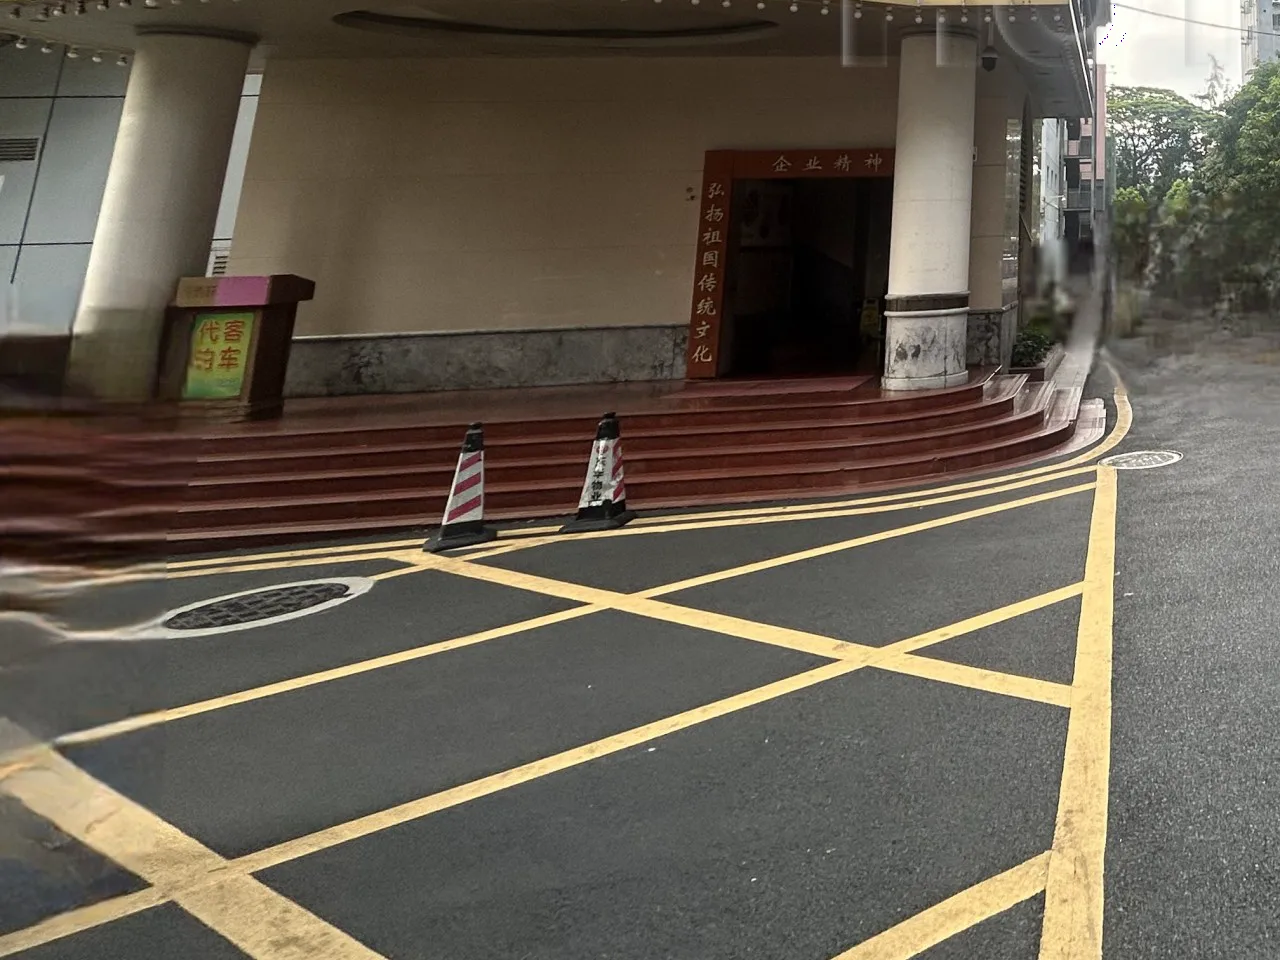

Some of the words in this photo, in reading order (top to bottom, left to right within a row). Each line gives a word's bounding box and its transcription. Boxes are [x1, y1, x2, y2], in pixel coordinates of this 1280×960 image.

[772, 153, 883, 172] 企业精神
[691, 182, 725, 363] 弘扬祖国传统文化
[200, 319, 245, 345] 代客
